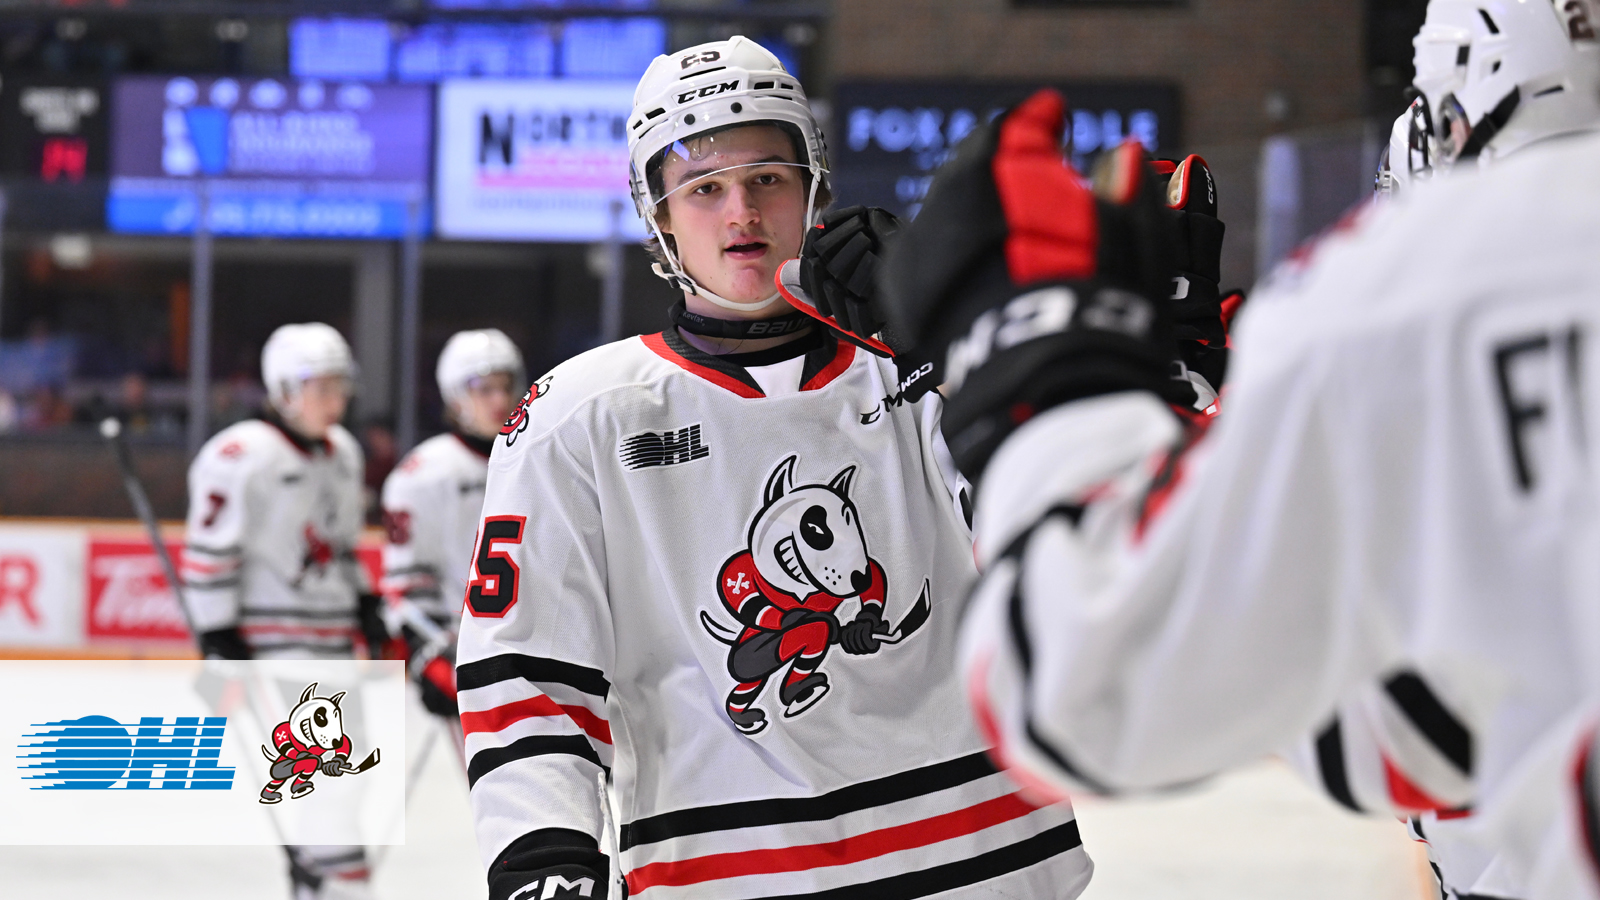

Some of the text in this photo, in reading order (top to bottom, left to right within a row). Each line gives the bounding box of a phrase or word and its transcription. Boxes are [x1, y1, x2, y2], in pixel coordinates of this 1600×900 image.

[677, 80, 740, 104] CCM
[1202, 165, 1214, 205] CCM
[900, 361, 934, 393] CCM
[619, 423, 710, 471] OHL
[463, 514, 527, 619] 5
